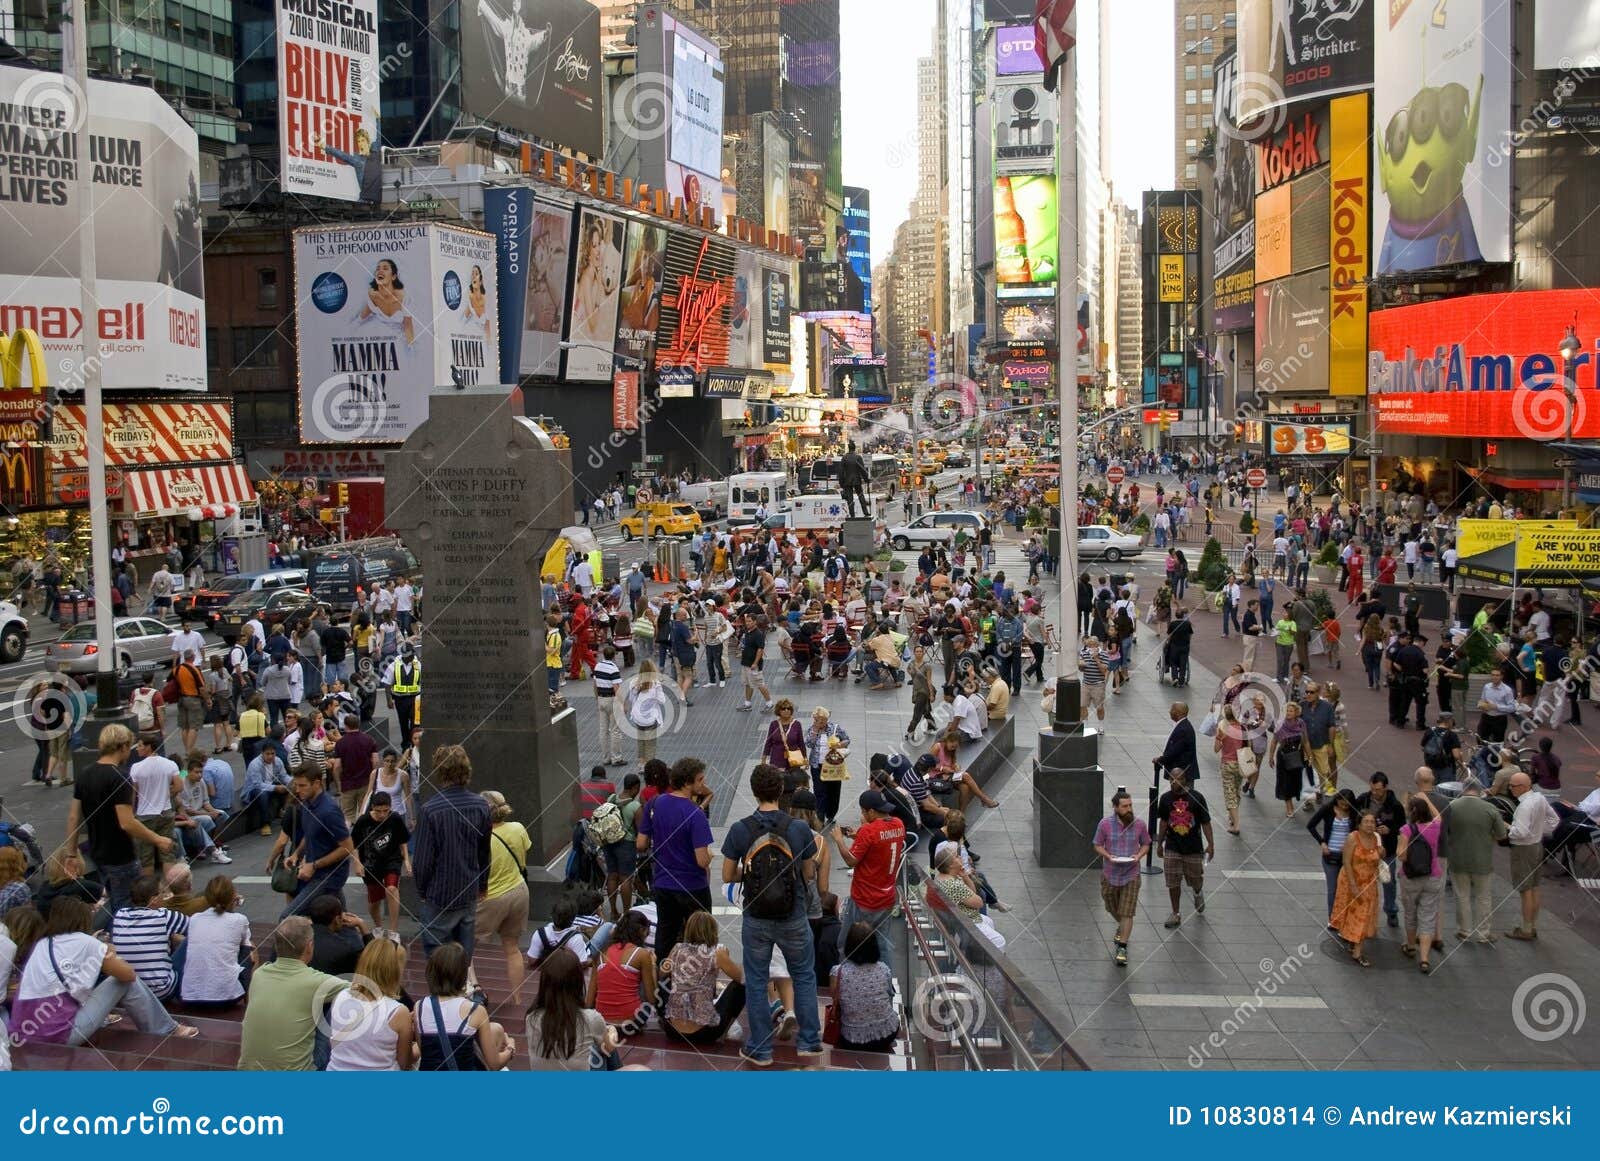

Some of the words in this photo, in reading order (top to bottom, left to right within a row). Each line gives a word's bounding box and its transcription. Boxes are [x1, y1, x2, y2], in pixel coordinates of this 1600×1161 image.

[282, 0, 377, 34] MUSICAL
[289, 13, 314, 40] 2009
[316, 20, 338, 46] TONY
[340, 27, 370, 54] AWARD
[1011, 40, 1035, 52] TD
[285, 41, 349, 109] BILLY
[350, 58, 362, 95] MUSICAL
[1285, 64, 1331, 87] 2009
[351, 97, 362, 112] THE
[0, 102, 66, 129] WHERE
[287, 100, 363, 166] ELLIOT
[1257, 113, 1320, 191] Kodak
[0, 153, 143, 187] PERFORANCE
[0, 175, 69, 206] LIVES
[328, 229, 382, 244] FEEL-GOOD
[385, 227, 429, 241] MUSICAL
[507, 190, 520, 275] VORNADO
[316, 244, 327, 256] IS
[328, 244, 336, 255] A
[1333, 176, 1364, 318] Kodak
[1162, 271, 1181, 284] LION
[1162, 285, 1182, 297] KING
[168, 307, 201, 349] maxell
[618, 327, 634, 339] SICK
[331, 341, 400, 373] MAMMA
[451, 339, 485, 368] MAMMA
[1006, 365, 1050, 375] YAHOO!
[347, 372, 387, 403] MIA!
[707, 378, 744, 393] VORNADO
[1270, 415, 1352, 423] MARQUIS
[113, 430, 150, 443] FRIDAY'S
[180, 428, 213, 440] FRIDAY'S
[283, 451, 379, 465] DIGITAL
[174, 485, 199, 494] FRIDAY'S
[483, 479, 527, 491] DUFFY
[480, 508, 512, 518] PRIEST
[1535, 541, 1559, 551] ARE
[1562, 542, 1586, 552] YOU
[1546, 553, 1573, 563] NEW
[479, 578, 515, 586] SERVICE
[1535, 577, 1554, 585] OFFICE
